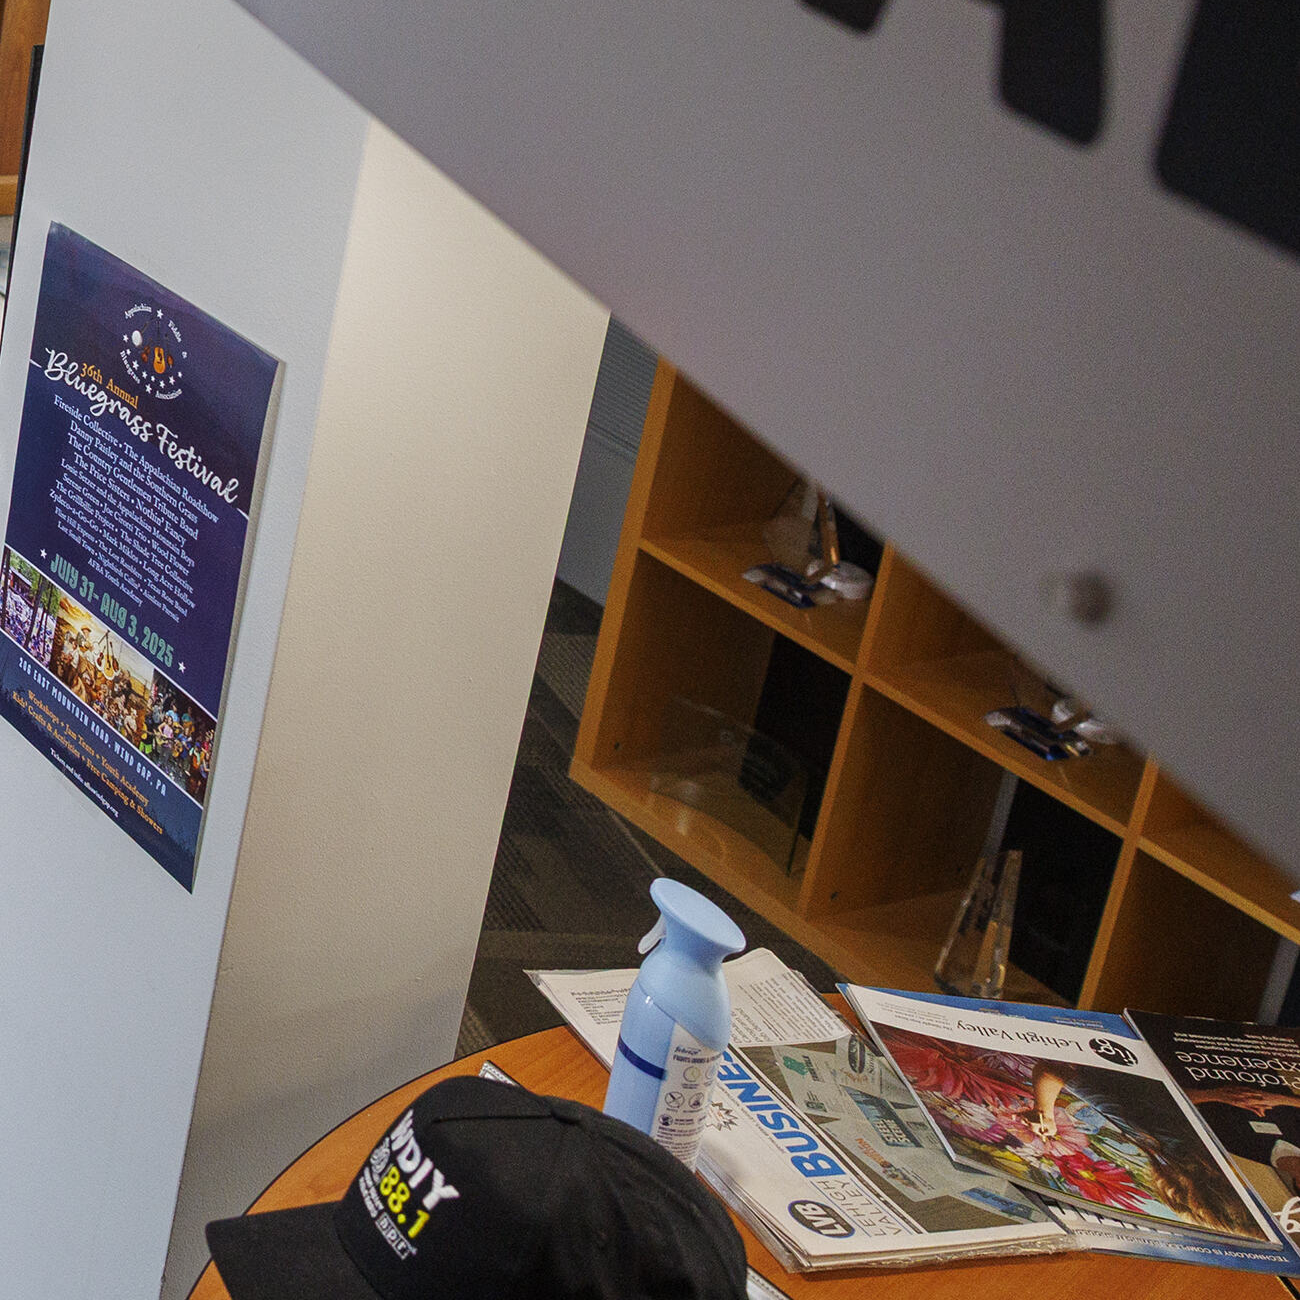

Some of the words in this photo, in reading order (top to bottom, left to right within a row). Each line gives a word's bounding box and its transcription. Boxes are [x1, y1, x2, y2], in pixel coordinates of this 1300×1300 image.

[80, 362, 103, 385] 36th
[106, 378, 139, 410] Annual
[44, 347, 154, 443] Bluegrass
[156, 423, 239, 504] Festival
[54, 394, 83, 421] Fireside
[83, 414, 119, 447] Collective
[123, 441, 139, 462] The
[139, 455, 181, 495] Appalachian
[181, 487, 219, 523] Roadshow
[67, 432, 83, 451] The
[82, 444, 113, 475] Country
[112, 466, 152, 503] Gentlemen
[153, 494, 179, 524] Tribute
[179, 517, 199, 541] Band
[70, 419, 94, 446] Danny
[94, 437, 119, 465] Paisley
[118, 458, 133, 473] and
[132, 466, 146, 482] the
[145, 475, 178, 508] Southern
[177, 500, 198, 524] Grass
[74, 451, 89, 471] The
[88, 463, 107, 485] Price
[107, 477, 131, 502] Sisters
[164, 520, 187, 548] Fancy
[127, 614, 139, 644] 3,
[141, 626, 174, 667] 2025
[956, 1019, 1013, 1040] Valley
[1015, 1028, 1083, 1051] Lehigh
[1174, 1051, 1300, 1072] xperience
[1184, 1066, 1300, 1090] Profound
[390, 1108, 460, 1210] WDIY
[380, 1165, 430, 1238] 88.1
[794, 1203, 849, 1236] LVB
[818, 1179, 887, 1237] LEHIGH
[834, 1179, 902, 1236] VALLEY
[1222, 1248, 1289, 1262] TECHNOLOGY
